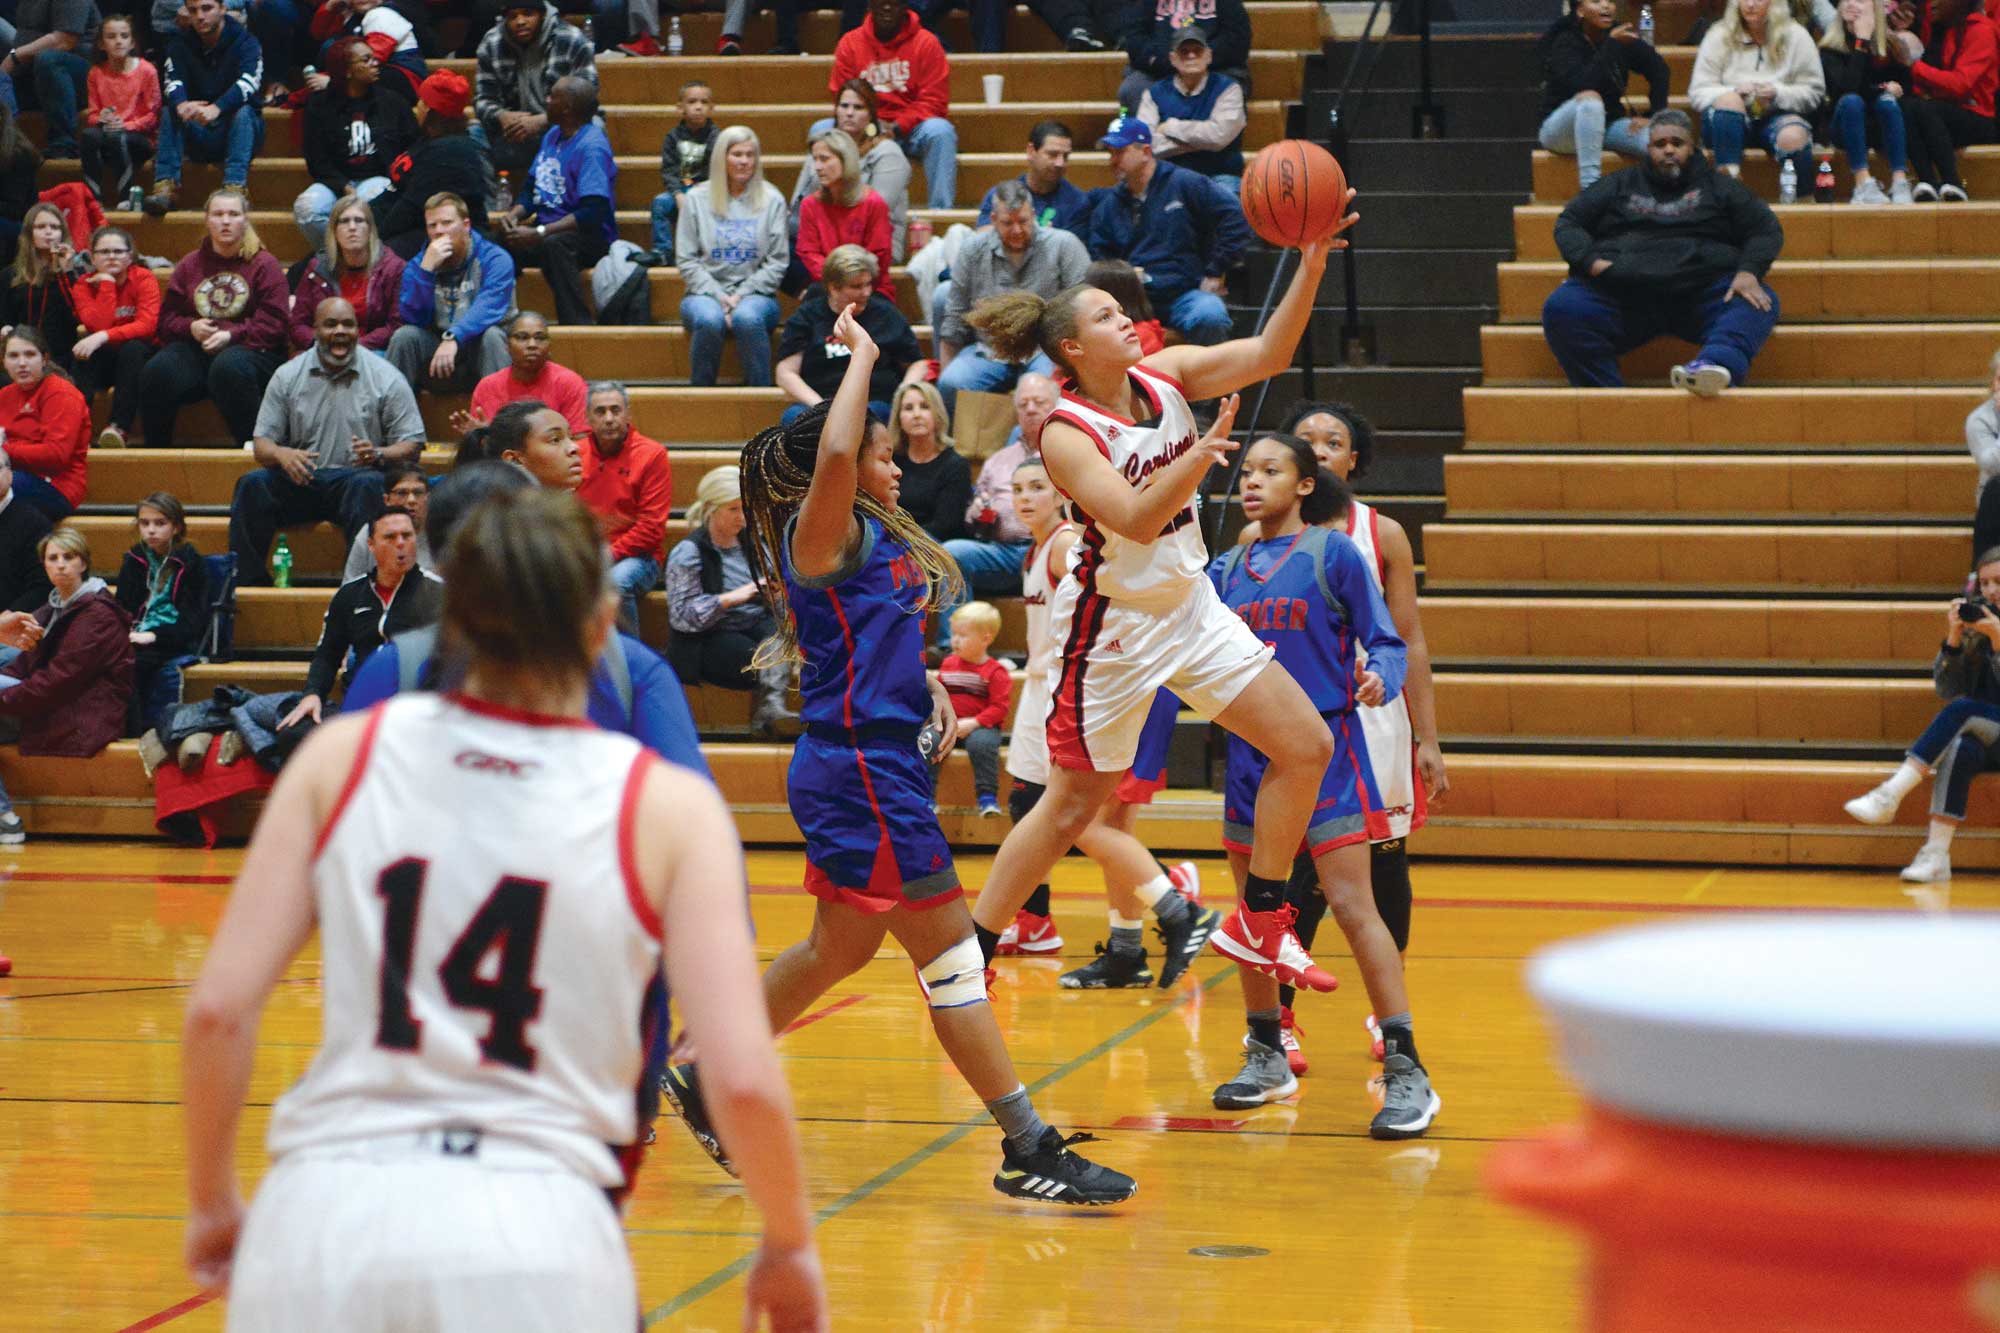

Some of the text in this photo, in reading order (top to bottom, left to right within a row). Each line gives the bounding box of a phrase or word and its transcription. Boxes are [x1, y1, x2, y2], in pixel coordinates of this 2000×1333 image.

[1123, 428, 1197, 488] Cardinal
[1229, 596, 1309, 632] ERCER
[374, 856, 550, 1074] 14
